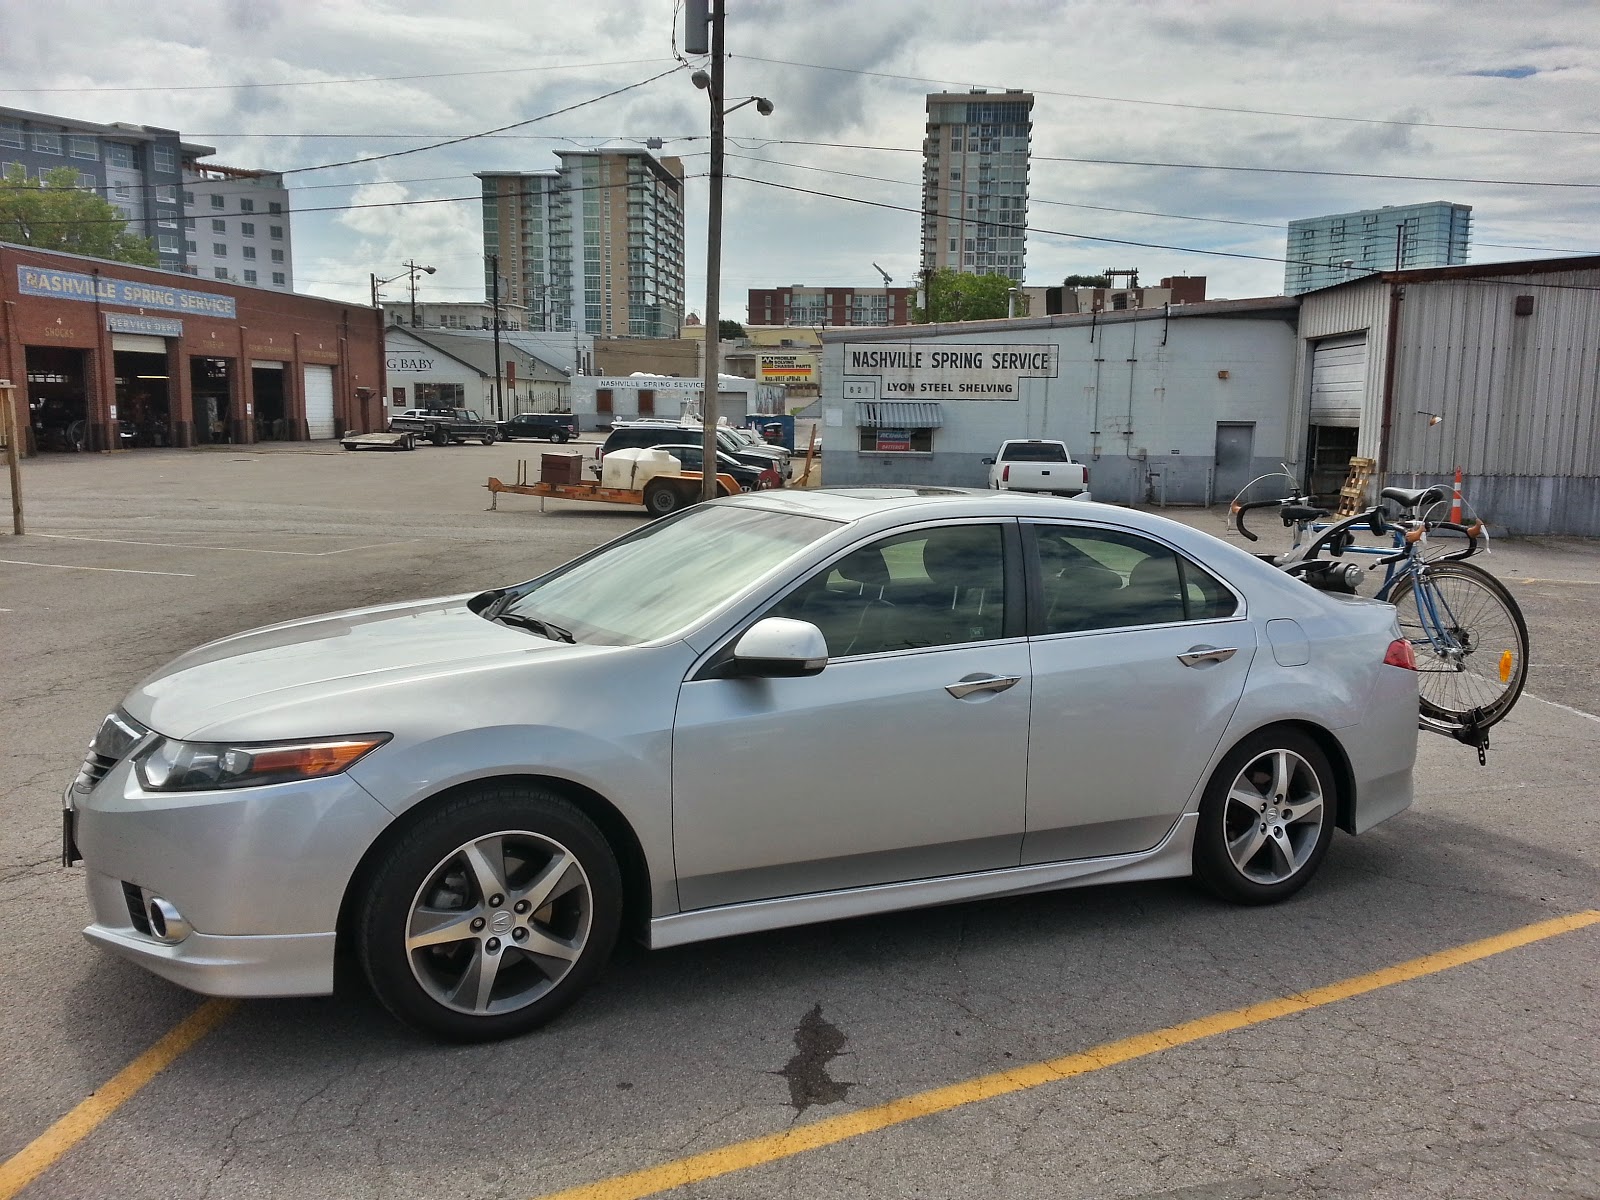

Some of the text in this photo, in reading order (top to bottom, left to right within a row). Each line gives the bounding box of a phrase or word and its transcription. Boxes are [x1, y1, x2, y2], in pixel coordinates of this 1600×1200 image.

[26, 272, 233, 313] NASHVILLE SPRING SERVICE
[56, 317, 62, 325] 4
[110, 317, 152, 330] SERVICE
[45, 327, 74, 339] SHOCKS
[211, 331, 216, 339] 6
[401, 359, 435, 369] BABY
[852, 351, 1048, 370] NASHVILLE SPRING SERVICE
[887, 382, 1013, 393] LYON STEEL SHELVING
